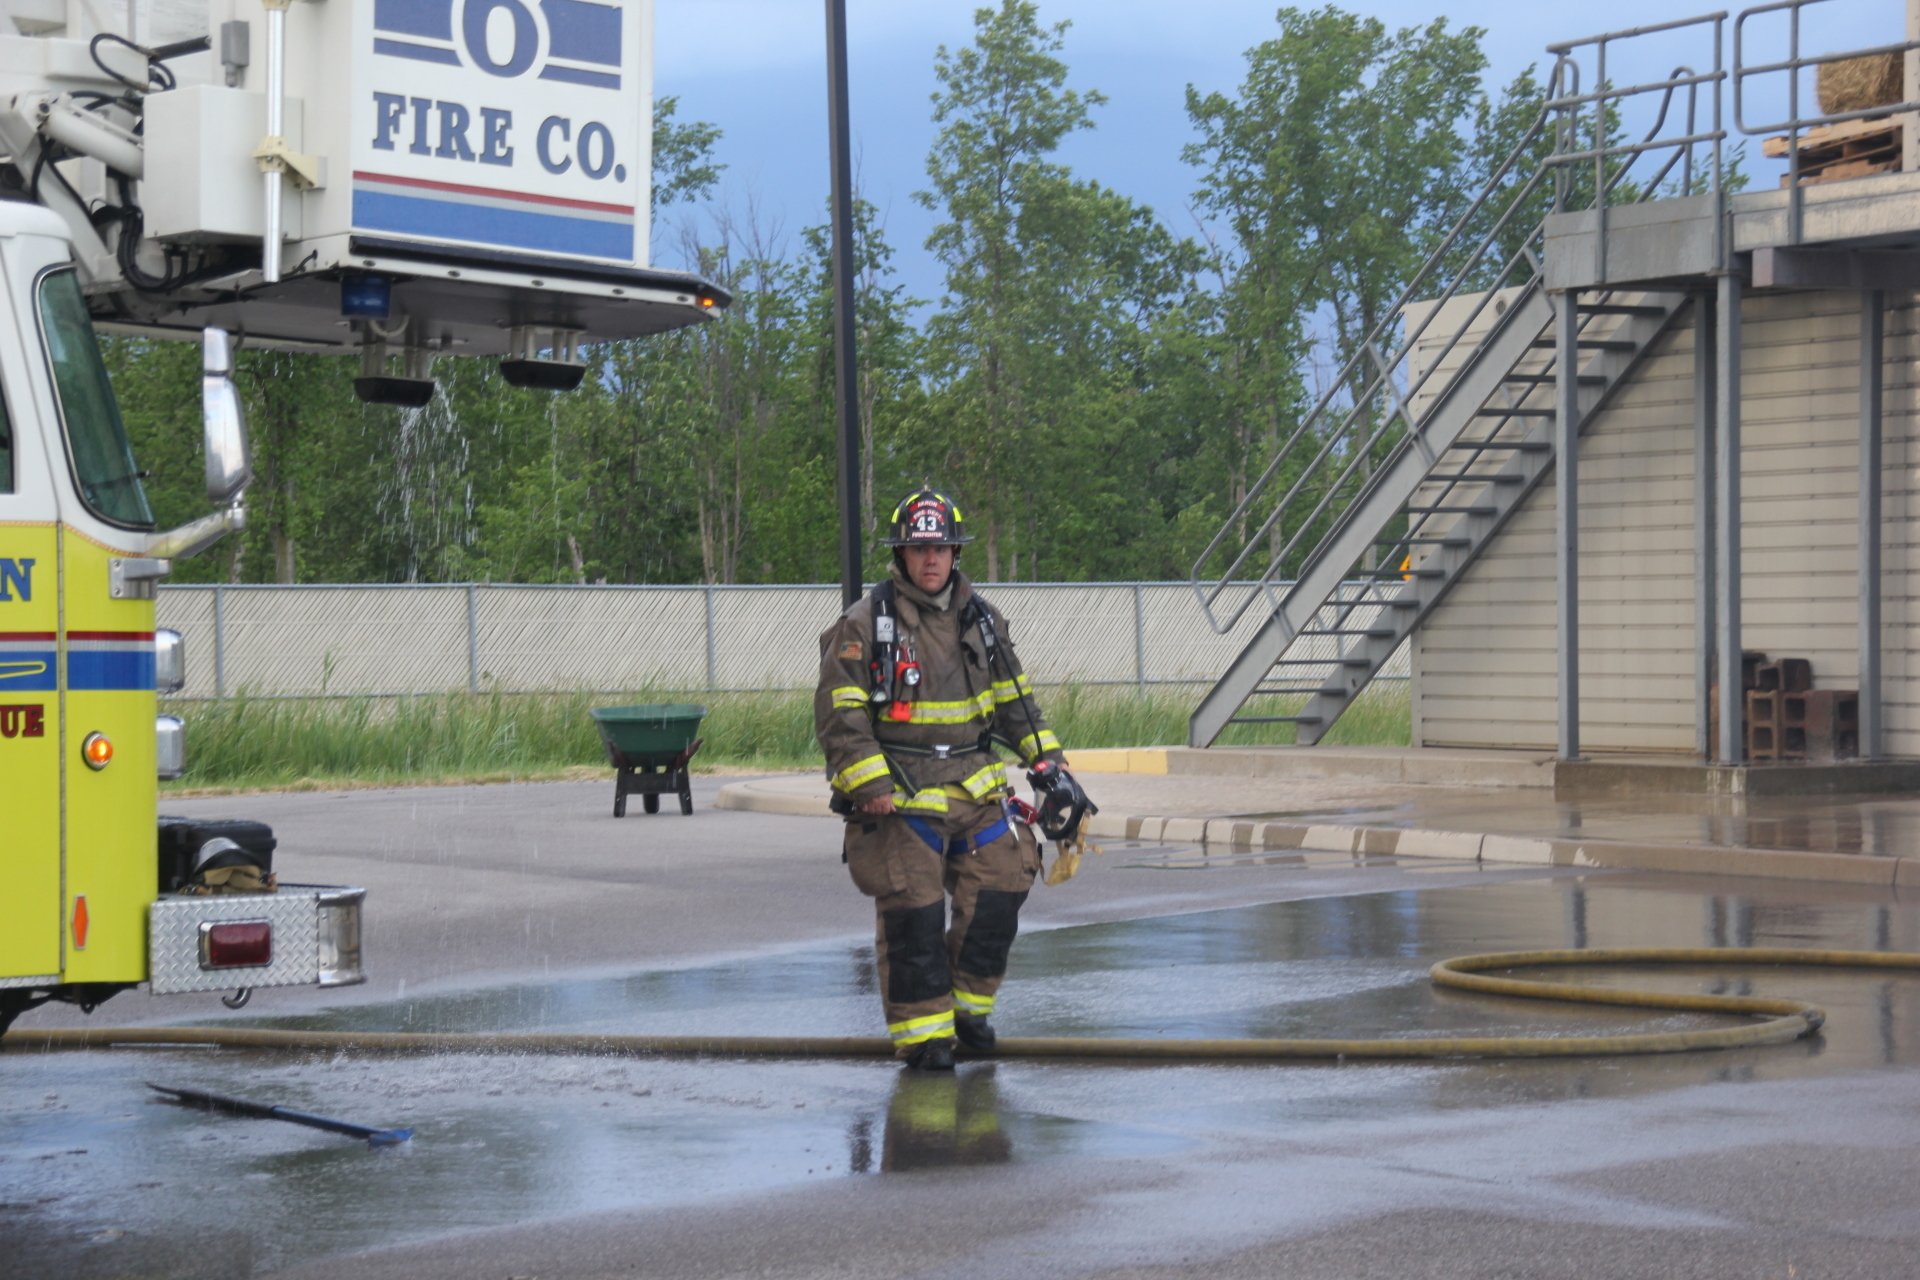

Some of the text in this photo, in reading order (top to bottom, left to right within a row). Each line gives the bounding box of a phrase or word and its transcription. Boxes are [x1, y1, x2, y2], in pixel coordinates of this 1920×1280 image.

[372, 91, 627, 183] FIRE CO.
[917, 516, 937, 531] 43
